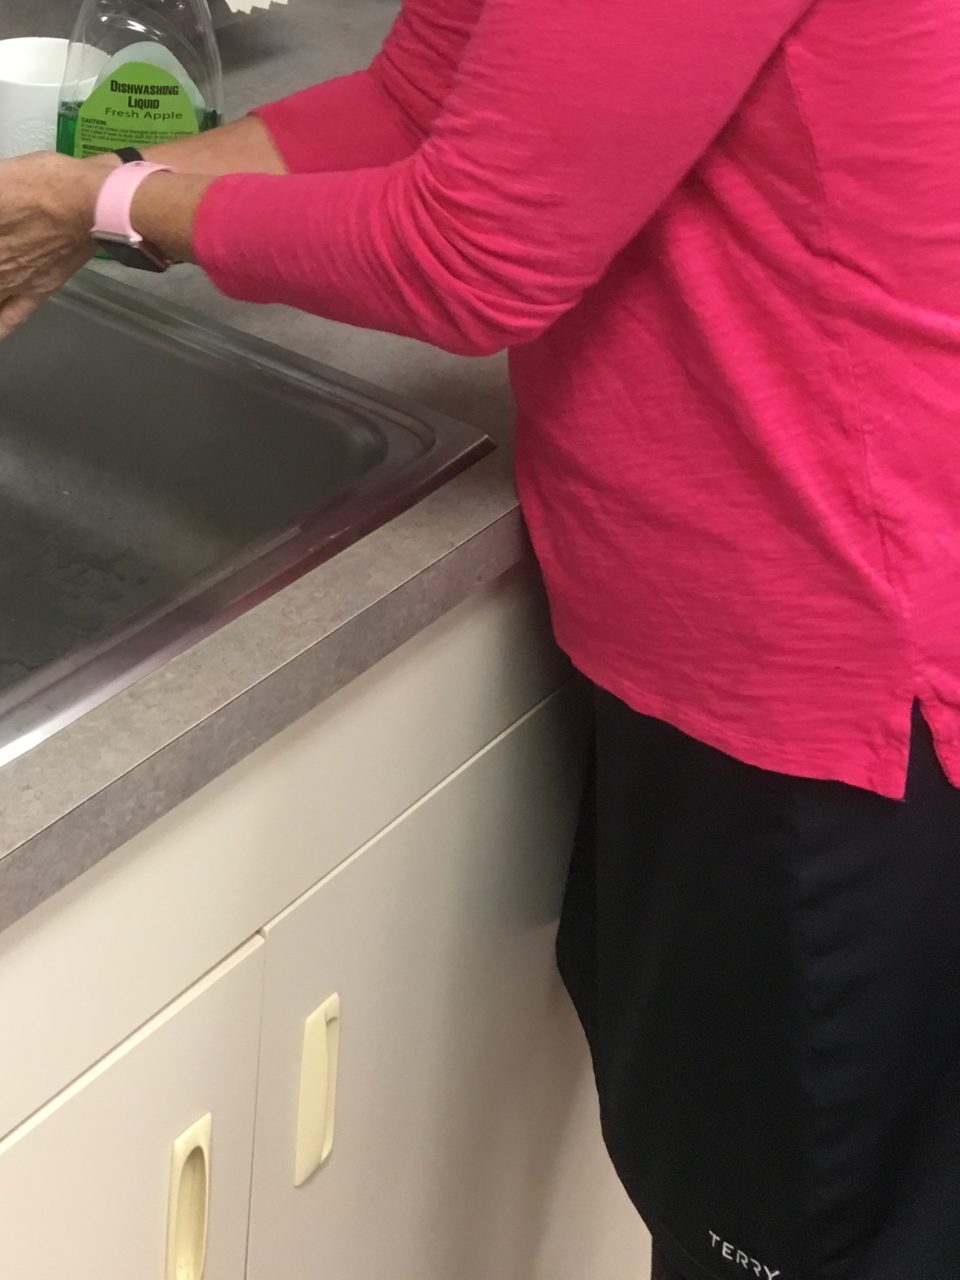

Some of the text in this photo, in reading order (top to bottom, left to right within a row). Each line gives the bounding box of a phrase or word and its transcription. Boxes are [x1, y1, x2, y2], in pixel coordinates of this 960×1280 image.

[105, 107, 183, 121] Fresh Apple
[708, 1230, 781, 1280] TERRY
